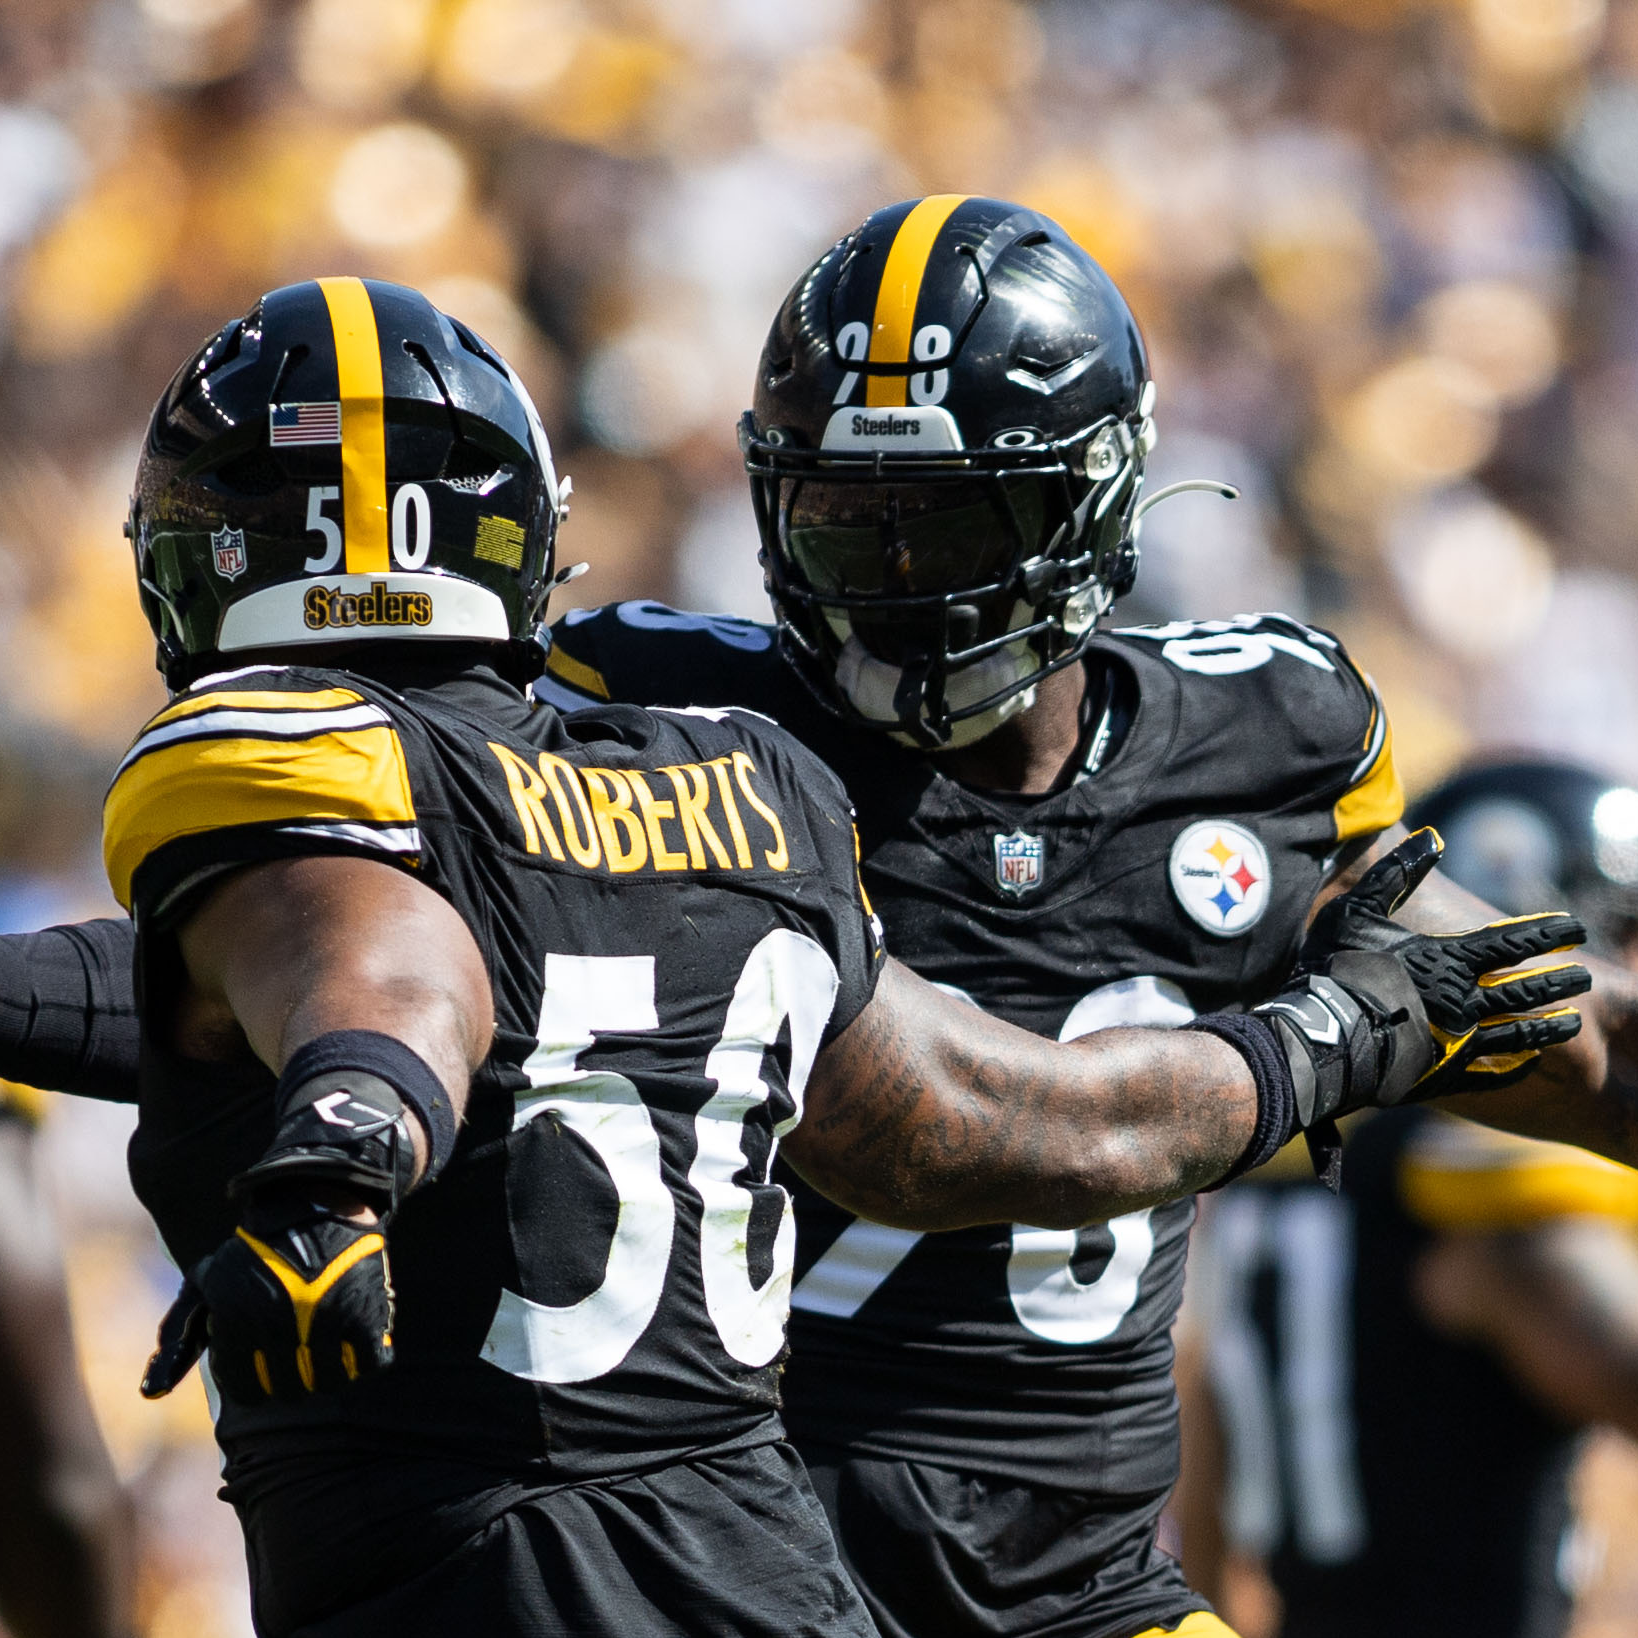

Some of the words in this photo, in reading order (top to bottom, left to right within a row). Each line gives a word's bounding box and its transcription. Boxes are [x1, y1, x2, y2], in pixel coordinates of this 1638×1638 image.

[852, 413, 920, 436] Steelers
[304, 483, 431, 573] 50
[217, 549, 243, 572] NFL
[304, 581, 433, 631] Steelers
[487, 740, 789, 874] ROBERTS
[1005, 859, 1036, 883] NFL
[479, 928, 841, 1384] 50
